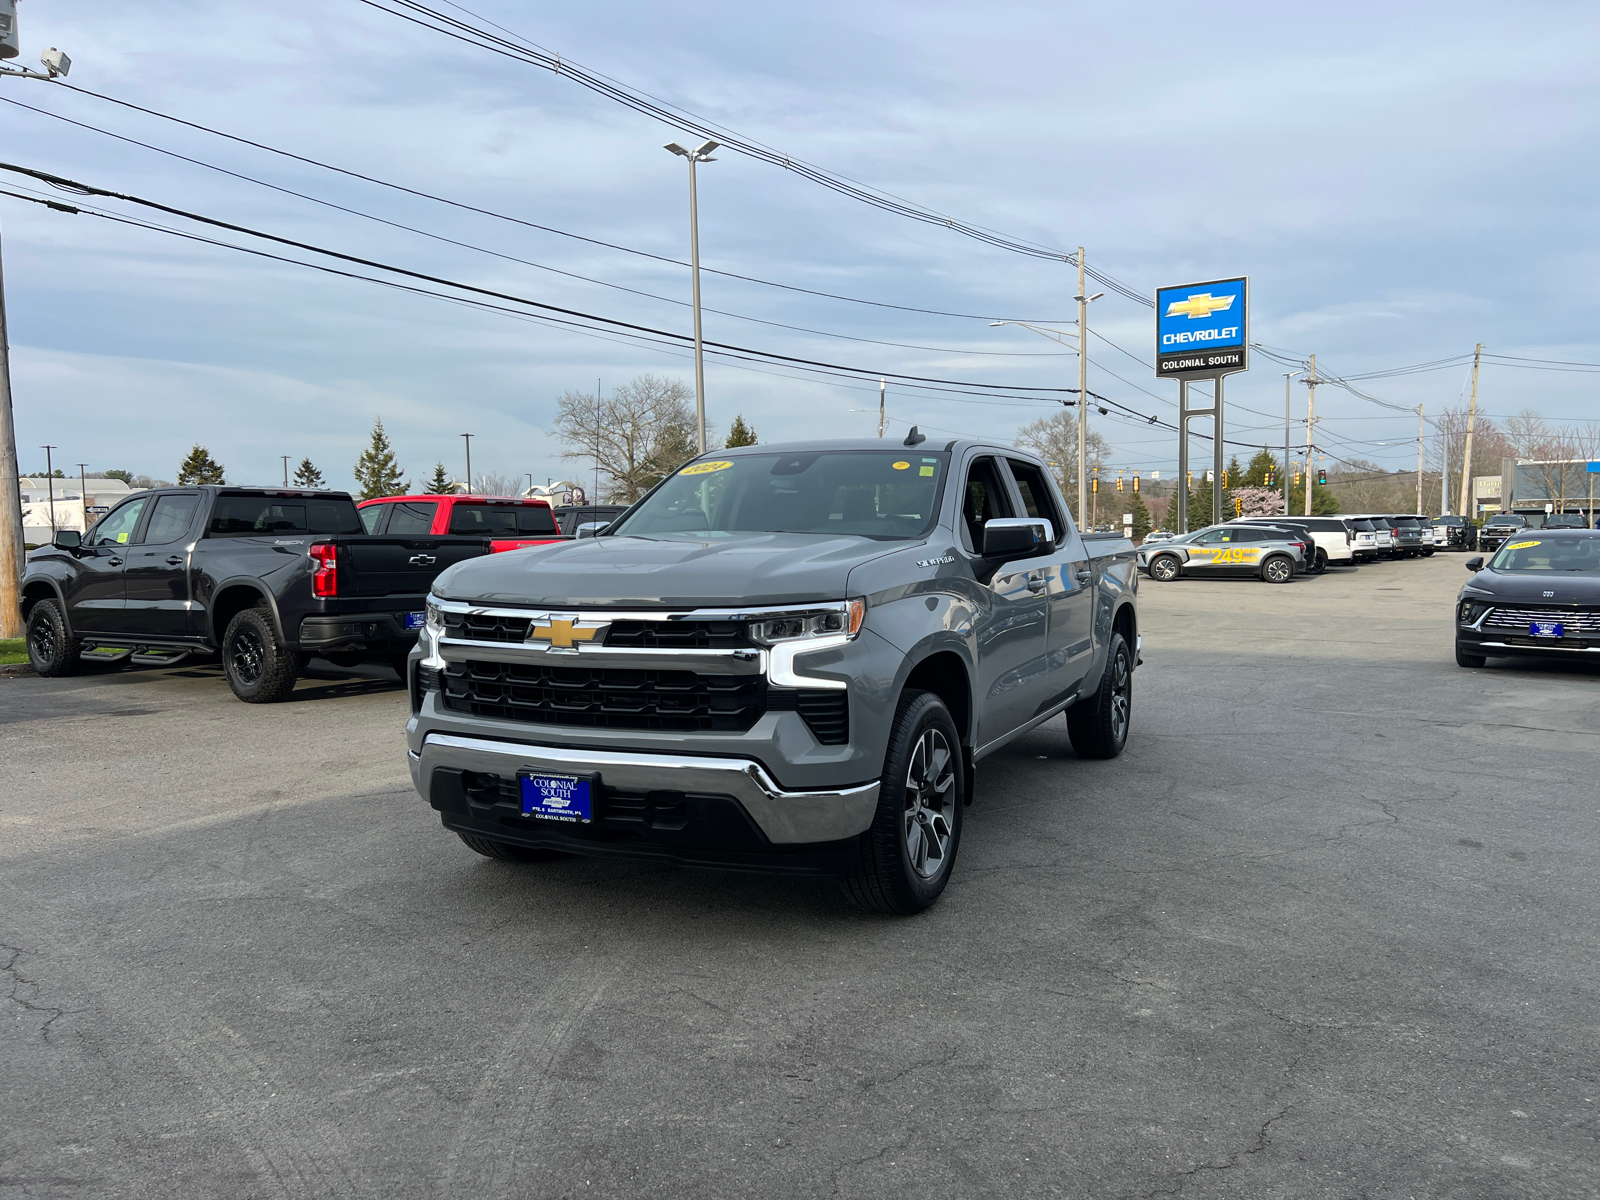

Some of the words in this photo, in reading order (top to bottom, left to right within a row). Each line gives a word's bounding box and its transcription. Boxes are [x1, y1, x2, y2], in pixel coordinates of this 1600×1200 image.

[1162, 326, 1239, 345] CHEVROLET
[1162, 358, 1206, 370] COLONIAL
[1208, 354, 1239, 366] SOUTH
[533, 778, 578, 791] COLONIAL
[540, 787, 571, 798] SOUTH
